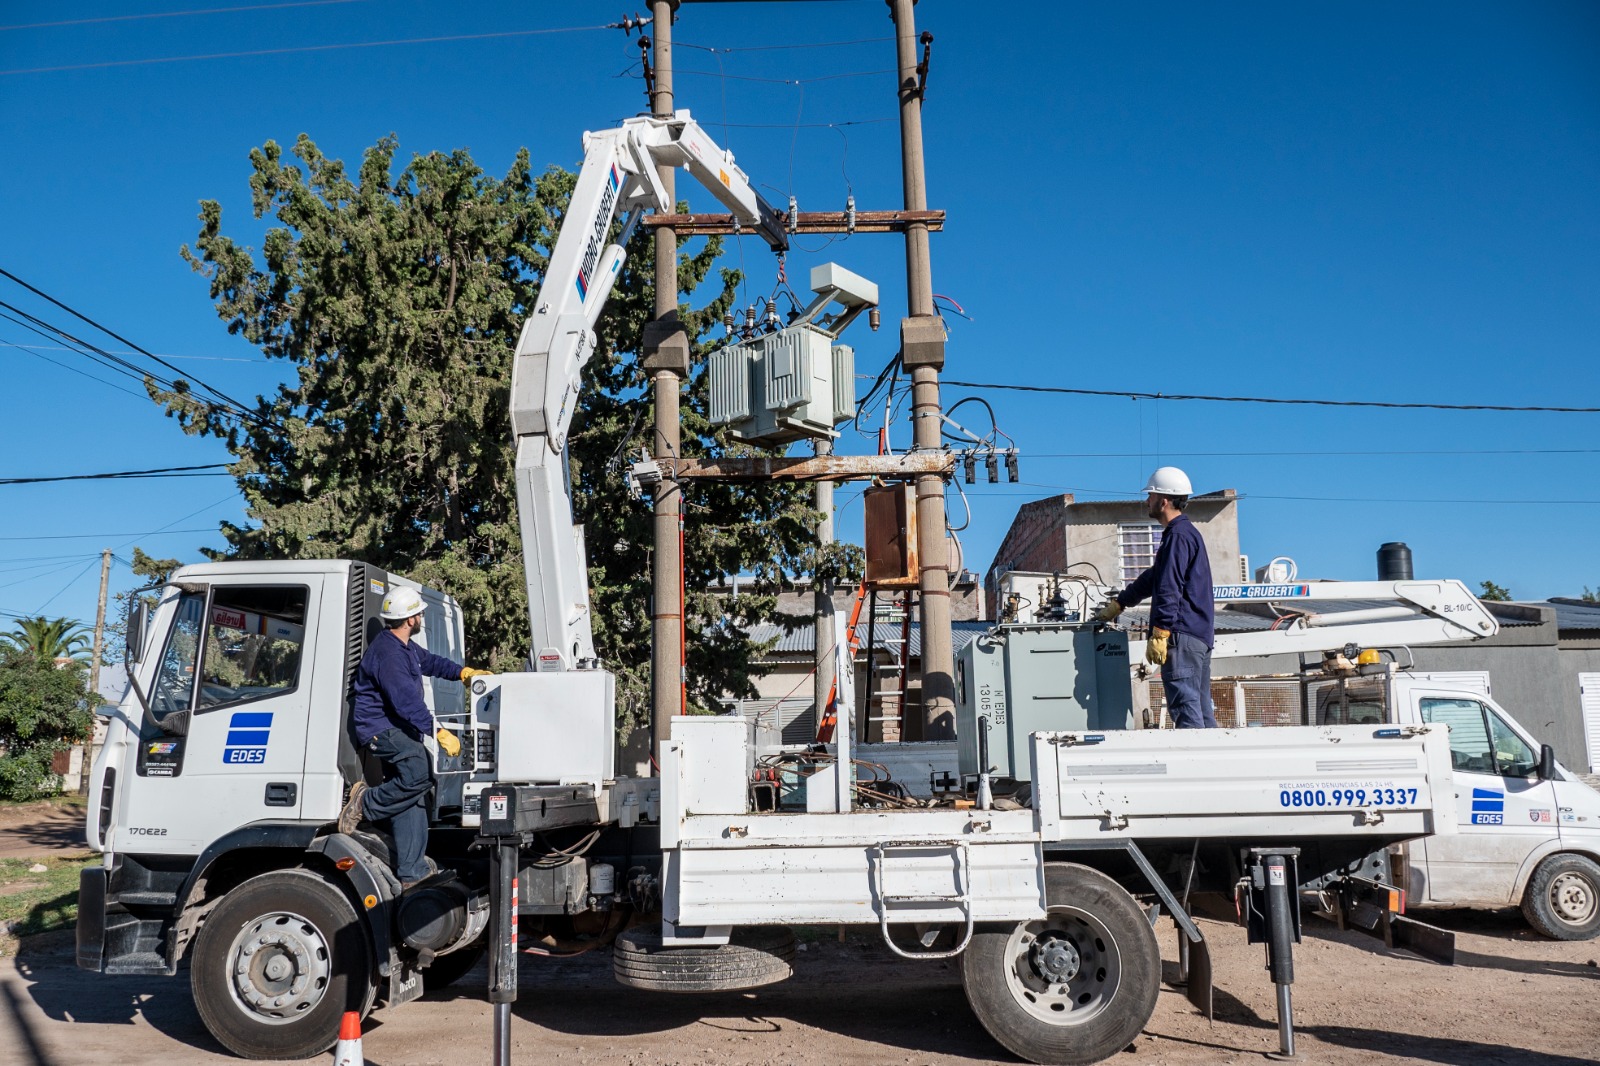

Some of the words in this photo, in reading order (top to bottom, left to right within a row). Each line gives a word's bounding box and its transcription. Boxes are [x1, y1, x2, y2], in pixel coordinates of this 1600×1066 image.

[580, 178, 615, 287] HIDRO-GRUBERT
[1444, 604, 1473, 613] BL-10/C
[230, 750, 264, 762] EDES
[1280, 788, 1418, 807] 0800.999.3337
[1476, 814, 1502, 823] EDES
[129, 827, 167, 836] 170E22
